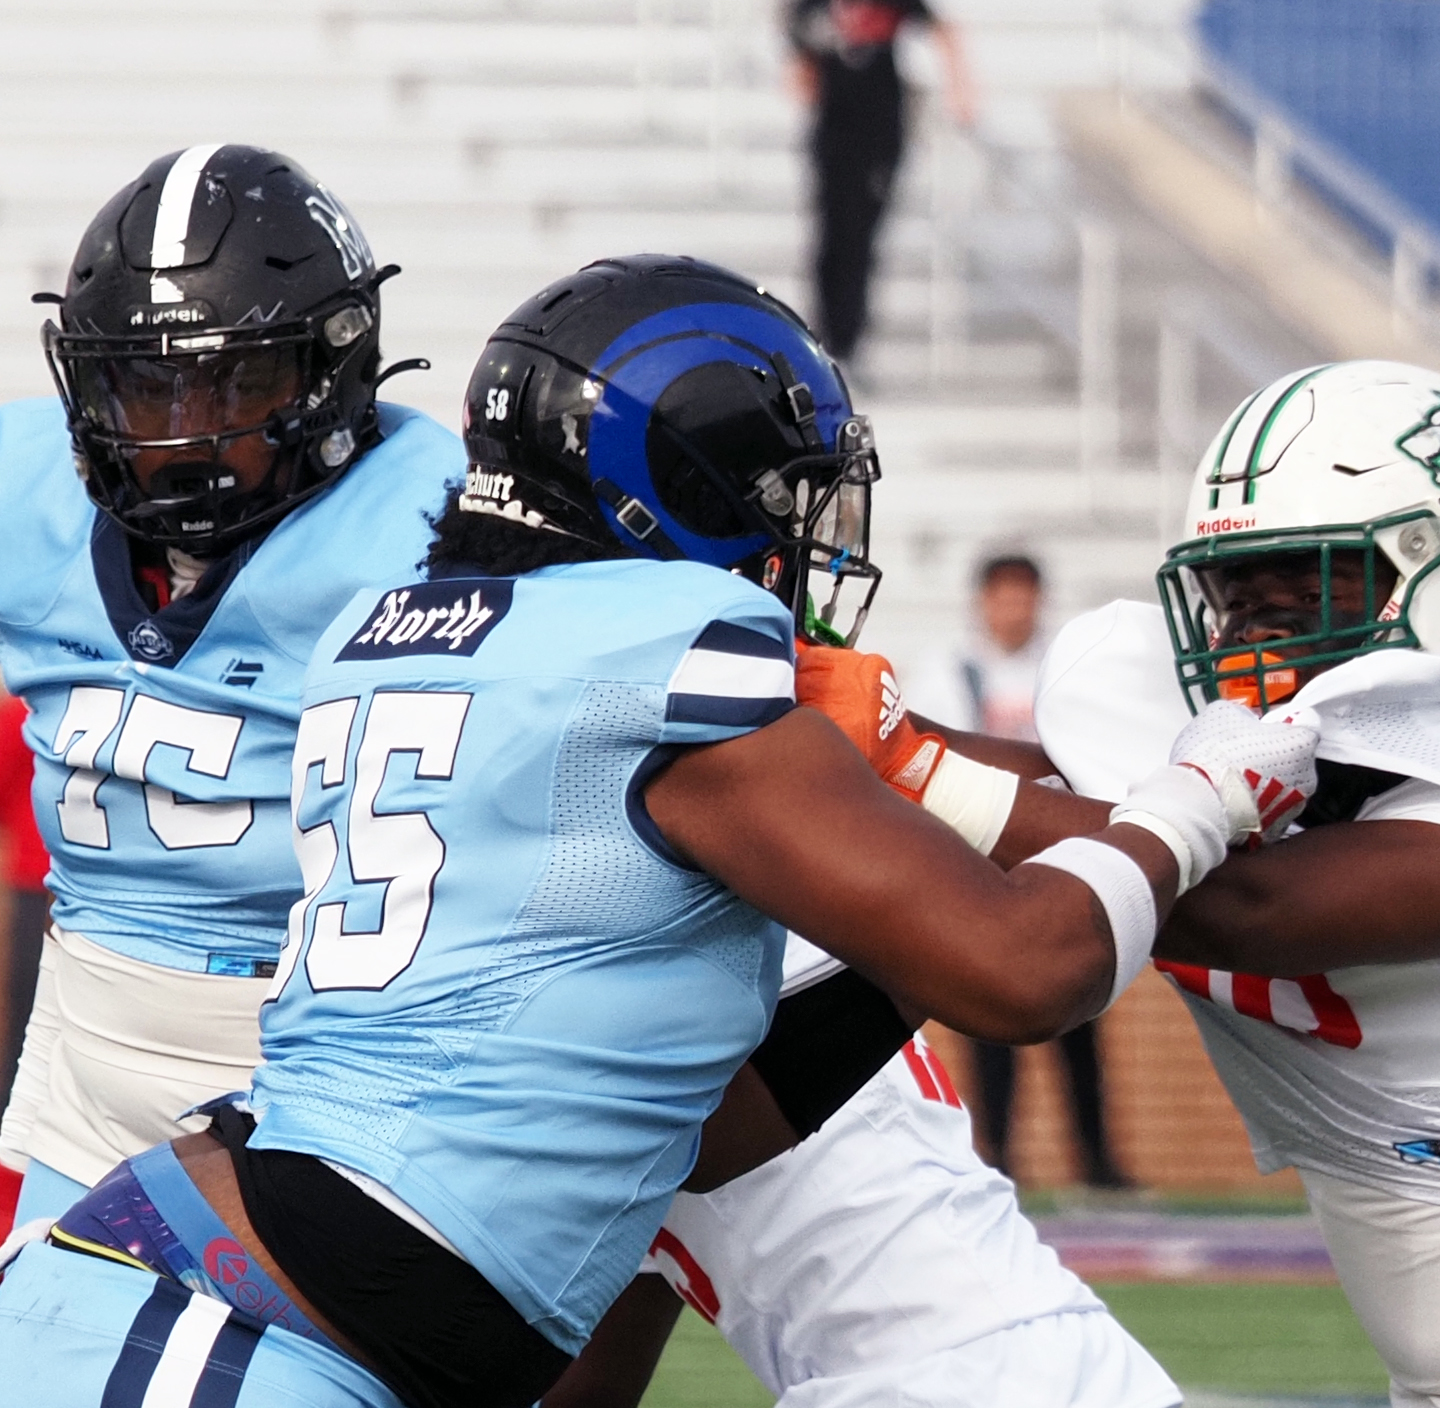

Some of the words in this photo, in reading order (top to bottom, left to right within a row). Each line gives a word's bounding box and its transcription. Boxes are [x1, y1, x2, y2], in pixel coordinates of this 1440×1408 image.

[485, 387, 510, 421] 58
[182, 521, 214, 532] Ridde
[354, 588, 494, 651] North
[260, 690, 475, 1003] 55
